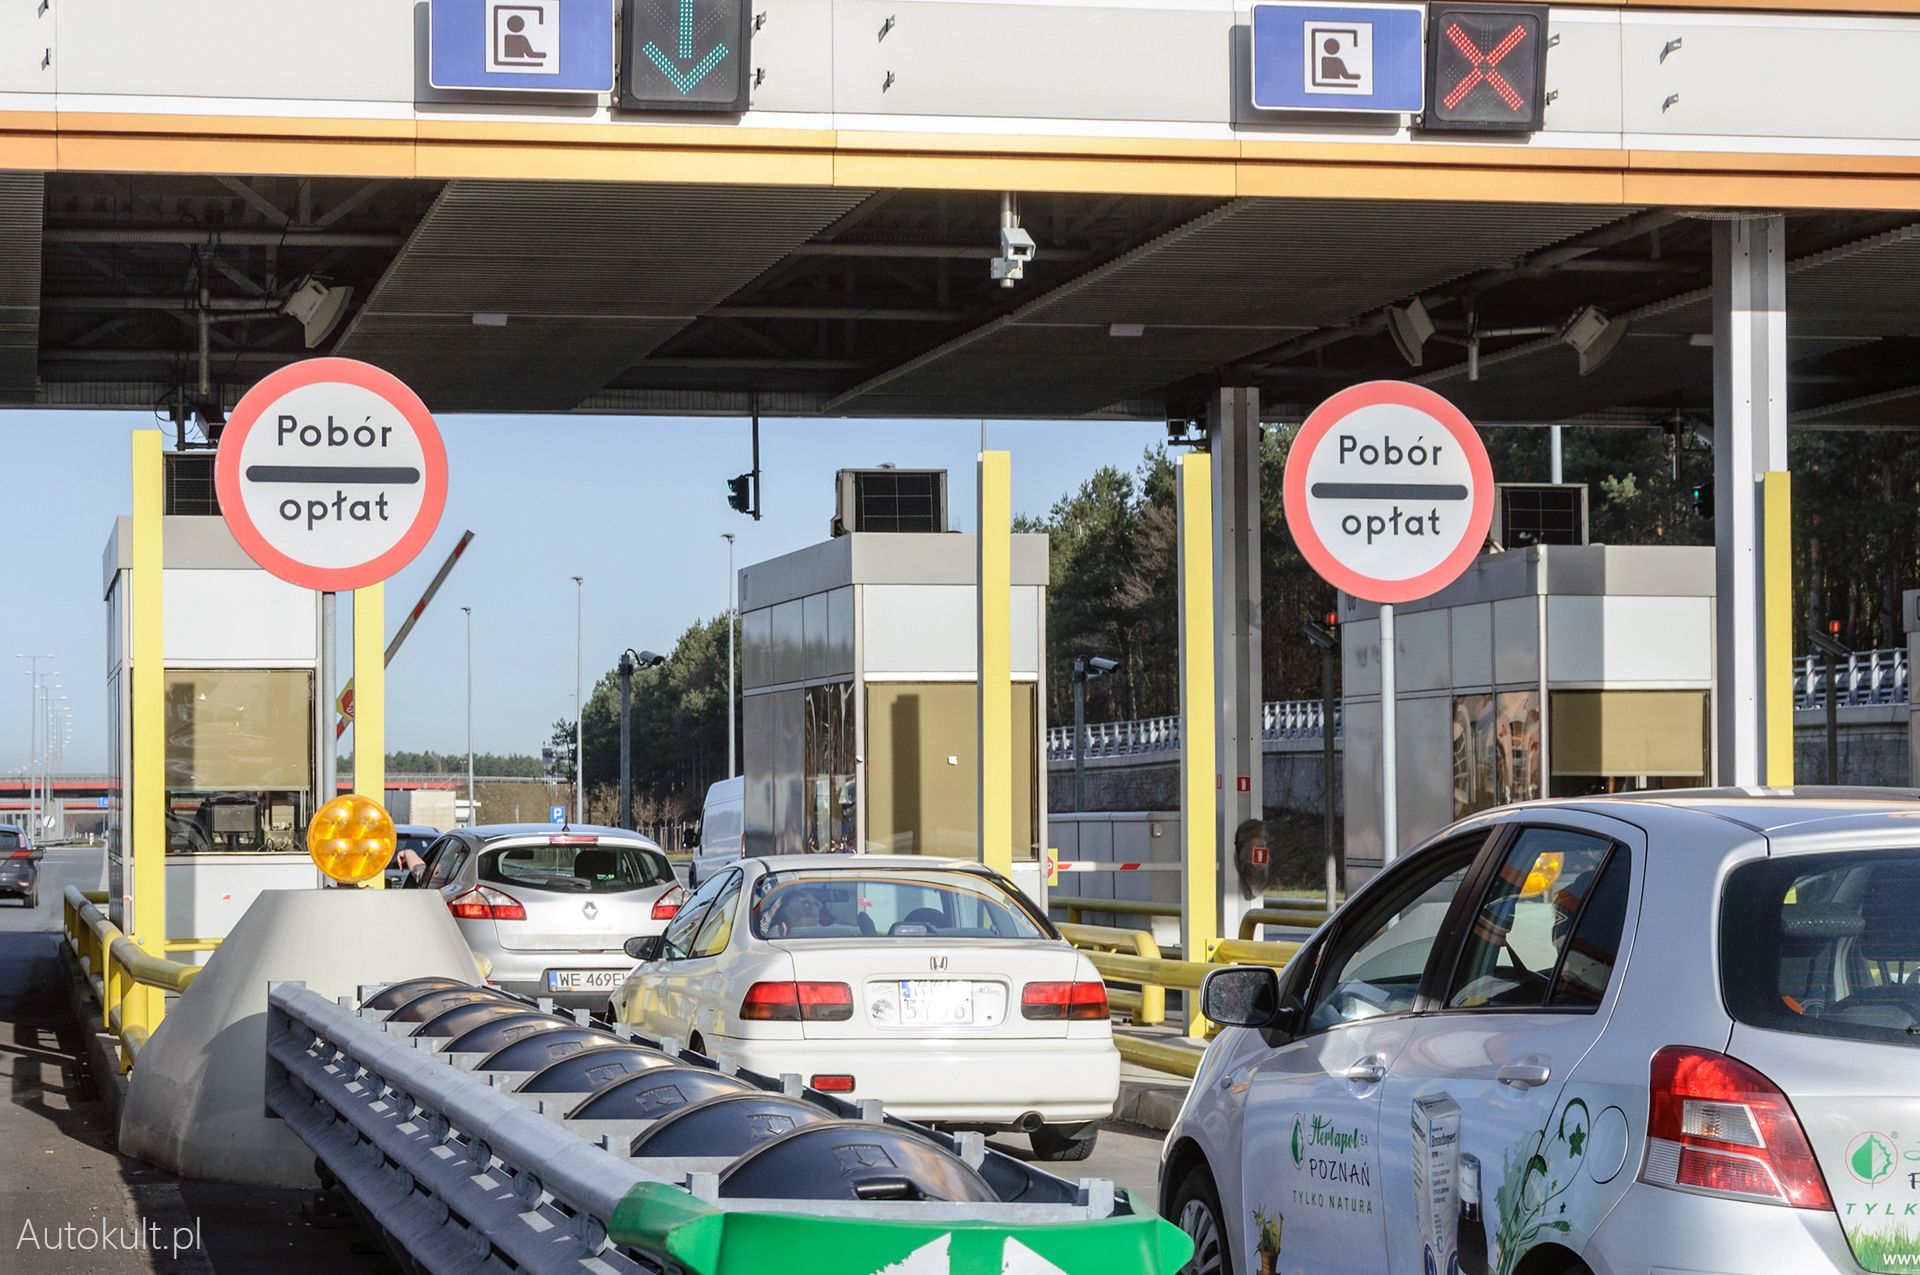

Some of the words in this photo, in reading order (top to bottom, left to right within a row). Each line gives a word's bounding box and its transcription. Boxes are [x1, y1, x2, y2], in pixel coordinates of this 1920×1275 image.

[278, 415, 392, 447] Pobór
[1340, 435, 1442, 465] Pobór
[279, 490, 389, 531] opłat
[1342, 506, 1440, 545] opłat
[560, 973, 580, 986] WE
[1309, 1159, 1370, 1187] POZNAŃ
[1293, 1190, 1324, 1208] TYLKO
[1329, 1195, 1373, 1214] NATURA
[1845, 1203, 1918, 1216] TYLK
